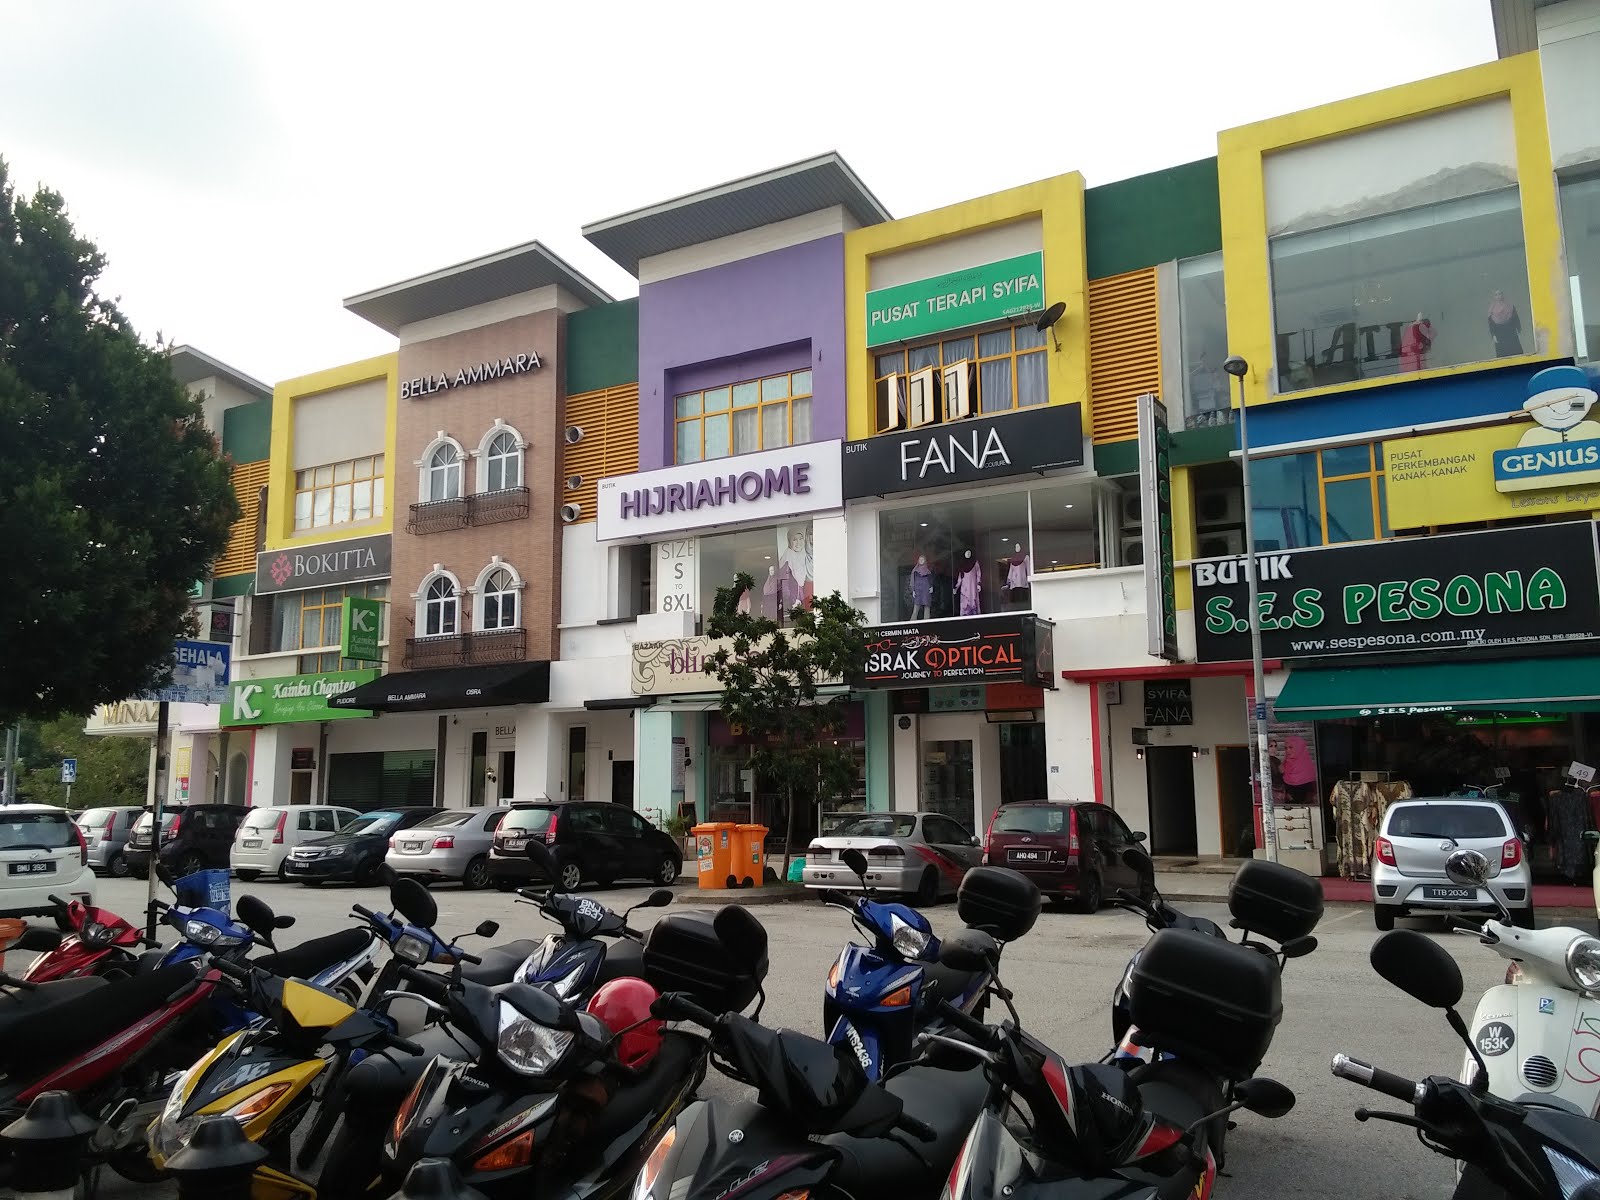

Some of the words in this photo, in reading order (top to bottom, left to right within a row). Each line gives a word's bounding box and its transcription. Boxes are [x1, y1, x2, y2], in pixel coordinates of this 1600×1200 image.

[871, 301, 920, 327] PUSAT
[927, 286, 987, 314] TERAPI
[992, 274, 1039, 299] SYIFA
[400, 372, 449, 400] BELLA
[453, 350, 542, 388] AMMARA
[845, 443, 868, 454] BUTIK
[900, 426, 1012, 481] FANA
[1390, 450, 1423, 462] PUSAT
[1502, 446, 1599, 473] GENIUS
[1391, 453, 1476, 472] PERKEMBANGAN
[1391, 465, 1468, 482] KANAK-KANAK
[601, 482, 616, 490] BUTIK
[620, 462, 811, 520] HIJRIAHOME
[661, 538, 694, 560] SIZE
[294, 547, 377, 577] BOKITTA
[674, 562, 684, 580] S
[1195, 554, 1294, 587] BUTIK
[663, 593, 693, 612] 8XL
[1205, 588, 1325, 635] S.E.S
[1343, 567, 1567, 625] PESONA
[634, 643, 664, 651] BAZAAR
[1291, 628, 1486, 652] www.sespesona.com.my
[925, 643, 1022, 669] OPTICAL
[901, 671, 931, 679] JOURNEY
[933, 670, 942, 678] TO
[943, 667, 984, 677] PERFECTION
[387, 694, 403, 702] BELLA
[404, 692, 426, 701] AMMARA
[466, 688, 482, 696] OSRA
[1147, 689, 1188, 699] SYIFA
[1144, 707, 1192, 723] FANA
[1377, 707, 1406, 715] S.E.S
[495, 726, 516, 736] BELLA
[1576, 769, 1589, 778] 49
[17, 864, 30, 873] BMU
[32, 863, 47, 872] 3921
[1432, 888, 1447, 896] TTB
[1448, 888, 1468, 897] 2036
[577, 905, 603, 921] 3637
[580, 899, 601, 912] BNJ
[1488, 1026, 1502, 1038] W
[1480, 1037, 1509, 1050] 153K
[462, 1075, 490, 1089] HONDA
[1101, 1091, 1134, 1116] HONDA
